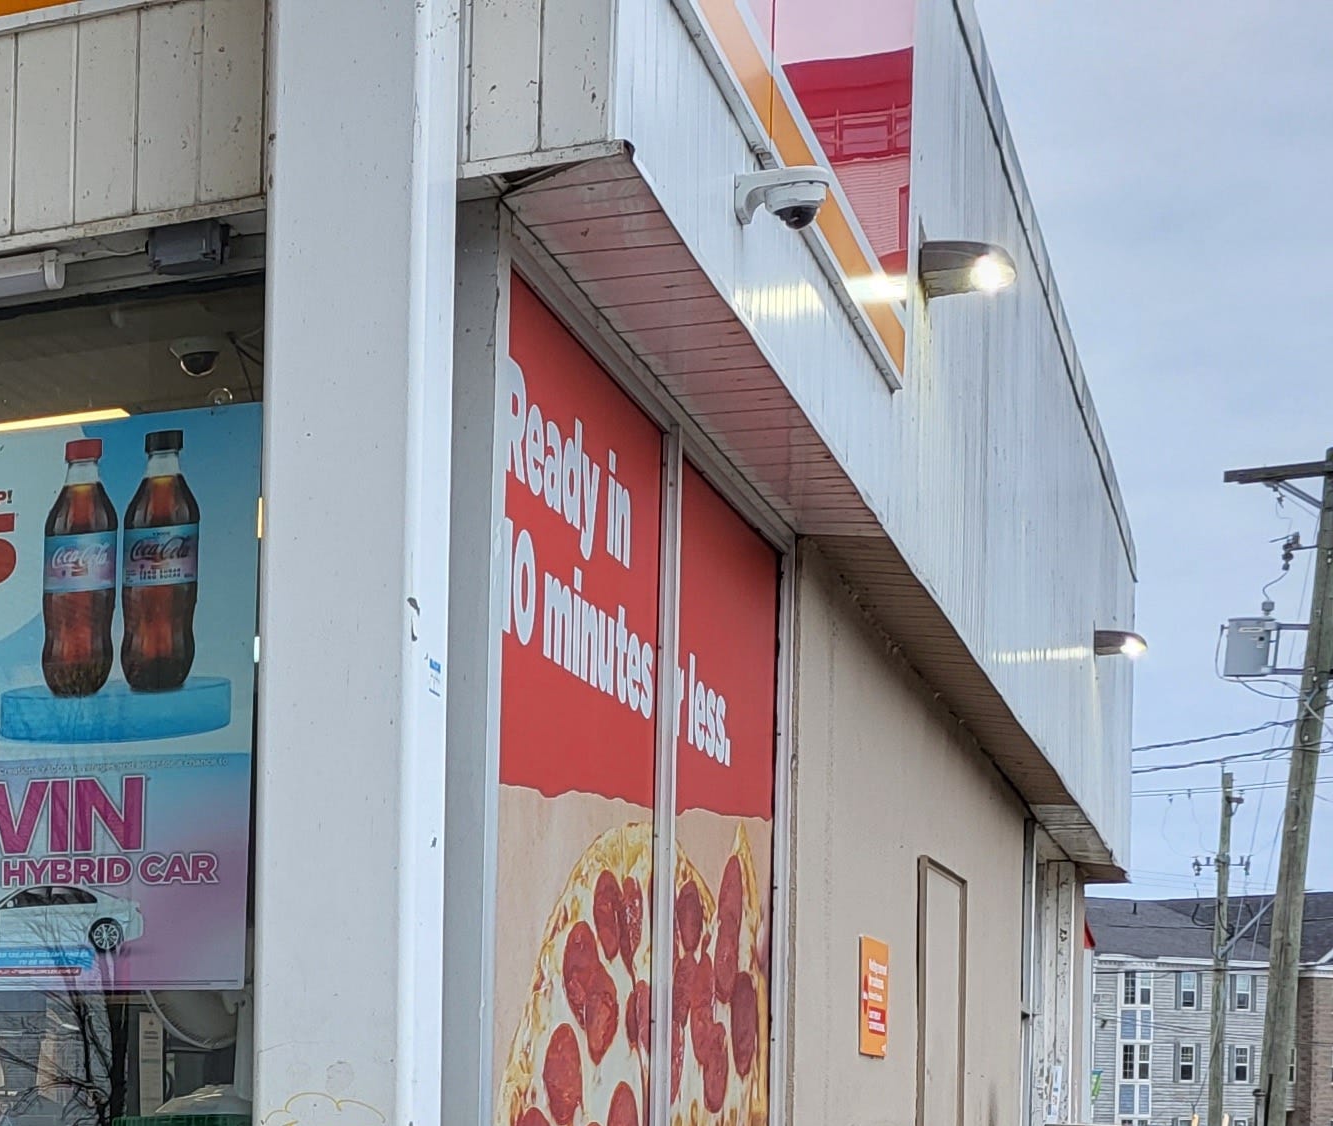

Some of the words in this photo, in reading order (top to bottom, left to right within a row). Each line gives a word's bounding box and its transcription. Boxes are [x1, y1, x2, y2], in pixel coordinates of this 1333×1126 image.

[505, 355, 600, 562] Ready
[606, 449, 631, 569] in
[501, 516, 536, 647] 10
[542, 566, 654, 720] minutes
[687, 652, 731, 768] less.
[2, 855, 136, 889] HYBRID
[138, 851, 219, 885] CAR
